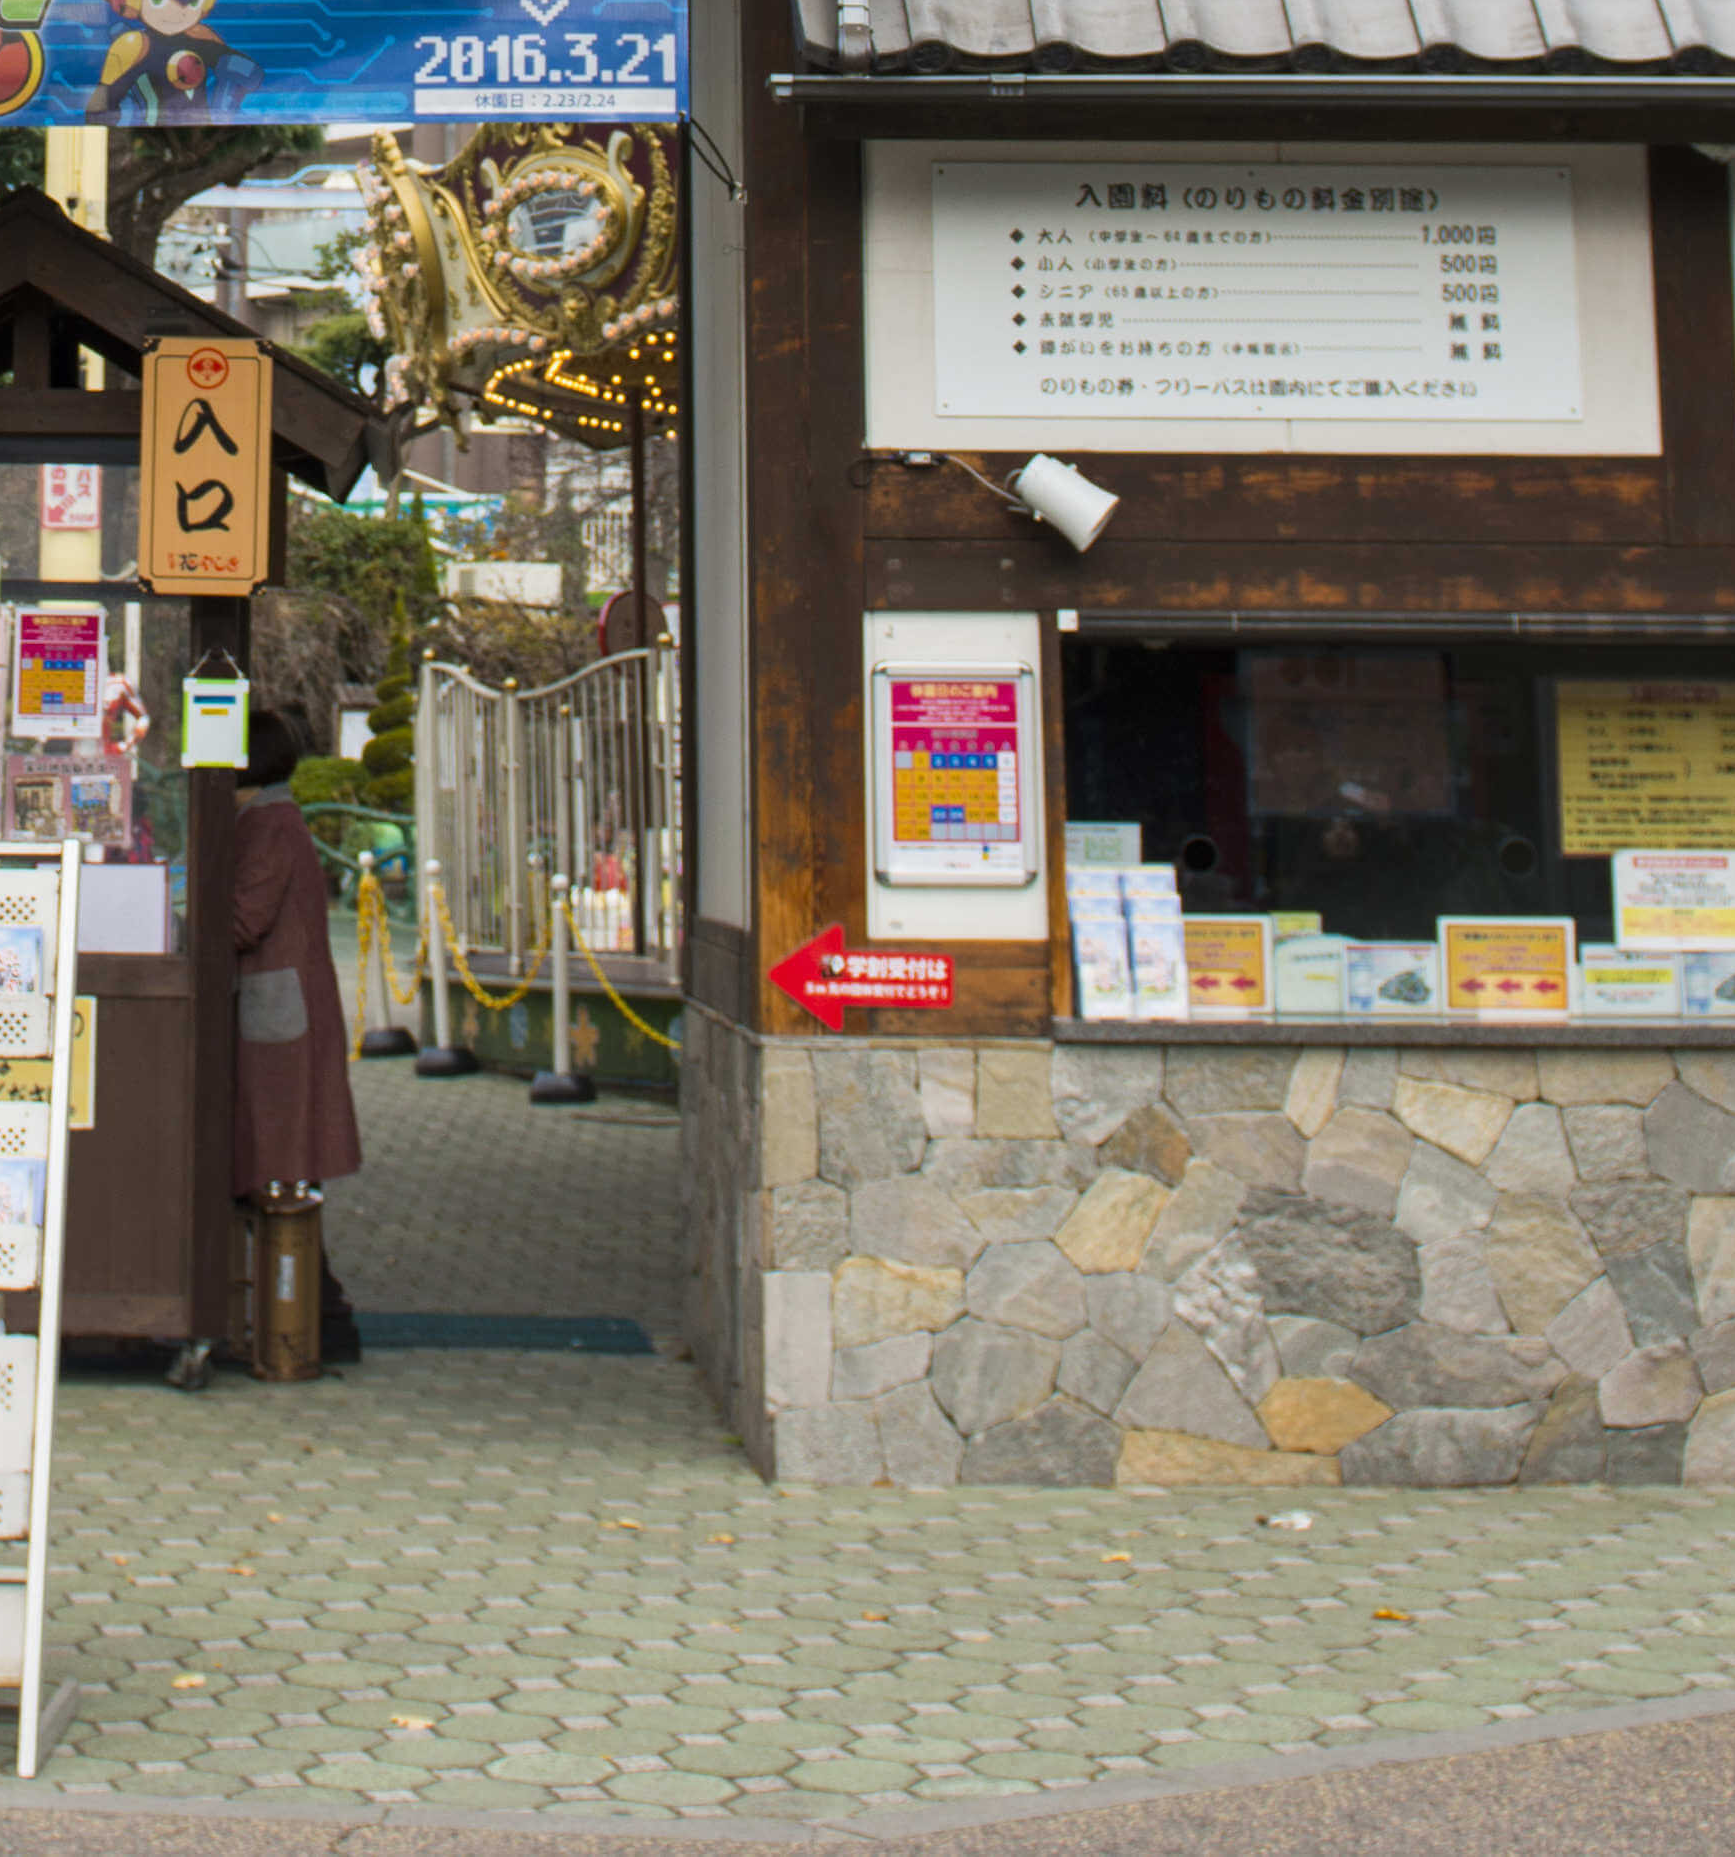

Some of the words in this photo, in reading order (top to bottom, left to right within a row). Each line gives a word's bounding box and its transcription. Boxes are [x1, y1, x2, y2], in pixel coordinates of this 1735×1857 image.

[413, 32, 677, 84] 2016.3.21
[1440, 254, 1498, 274] 500円
[1442, 283, 1500, 303] 500円
[173, 397, 239, 533] 入口
